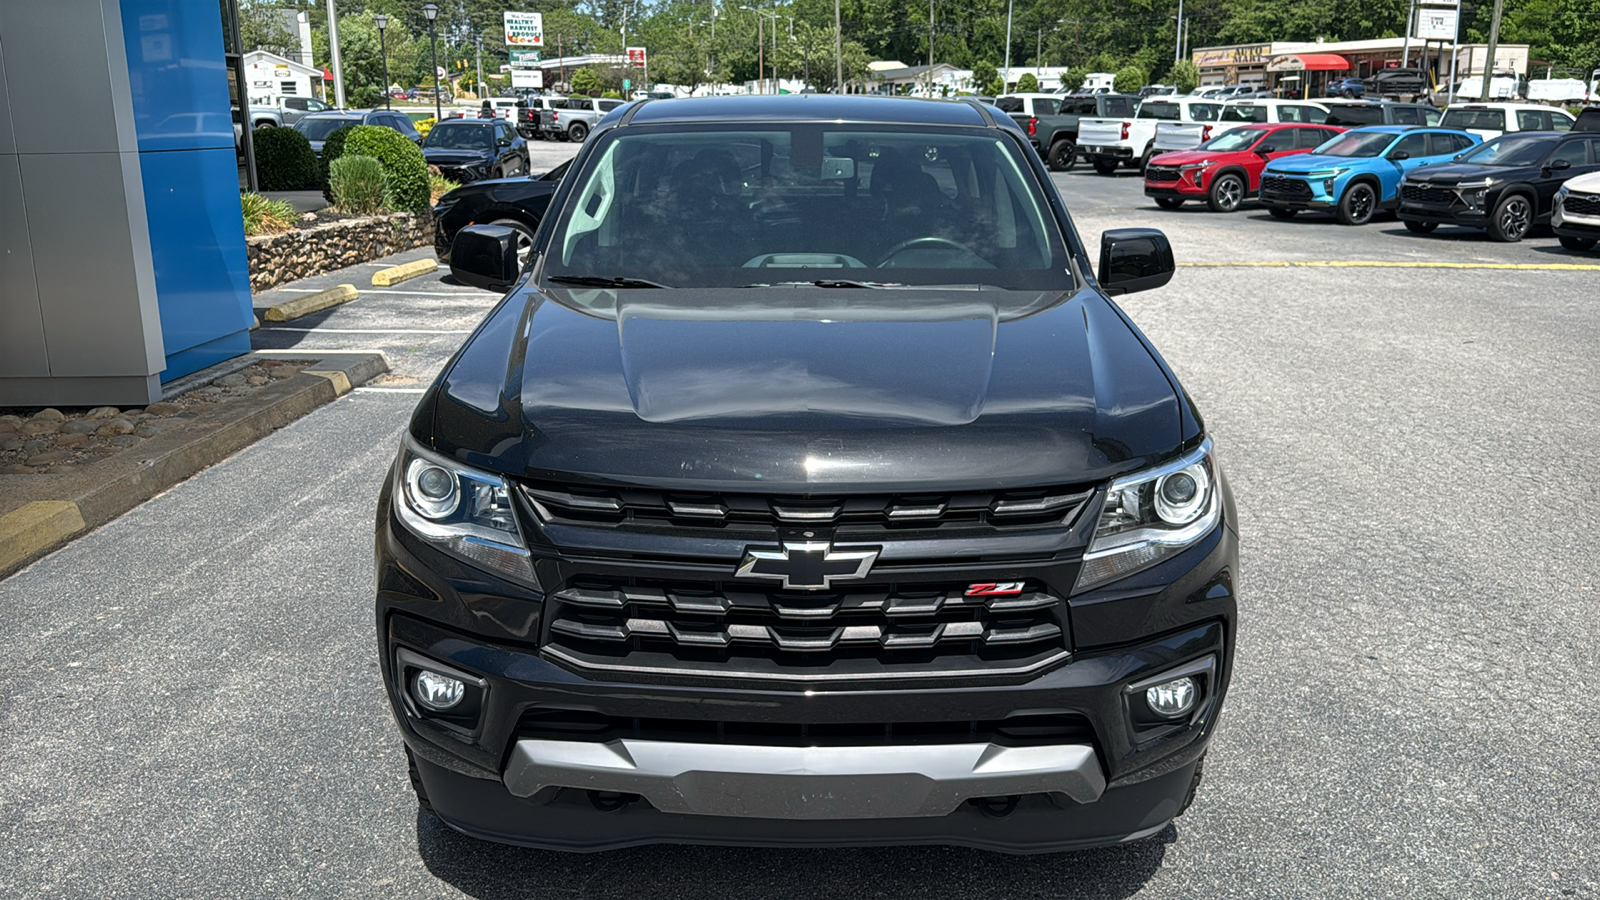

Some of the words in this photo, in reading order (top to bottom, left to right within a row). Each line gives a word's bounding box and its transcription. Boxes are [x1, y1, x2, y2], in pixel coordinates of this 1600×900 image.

[1234, 47, 1263, 56] AUTO
[1232, 55, 1263, 63] MART
[964, 581, 1026, 597] Z71
